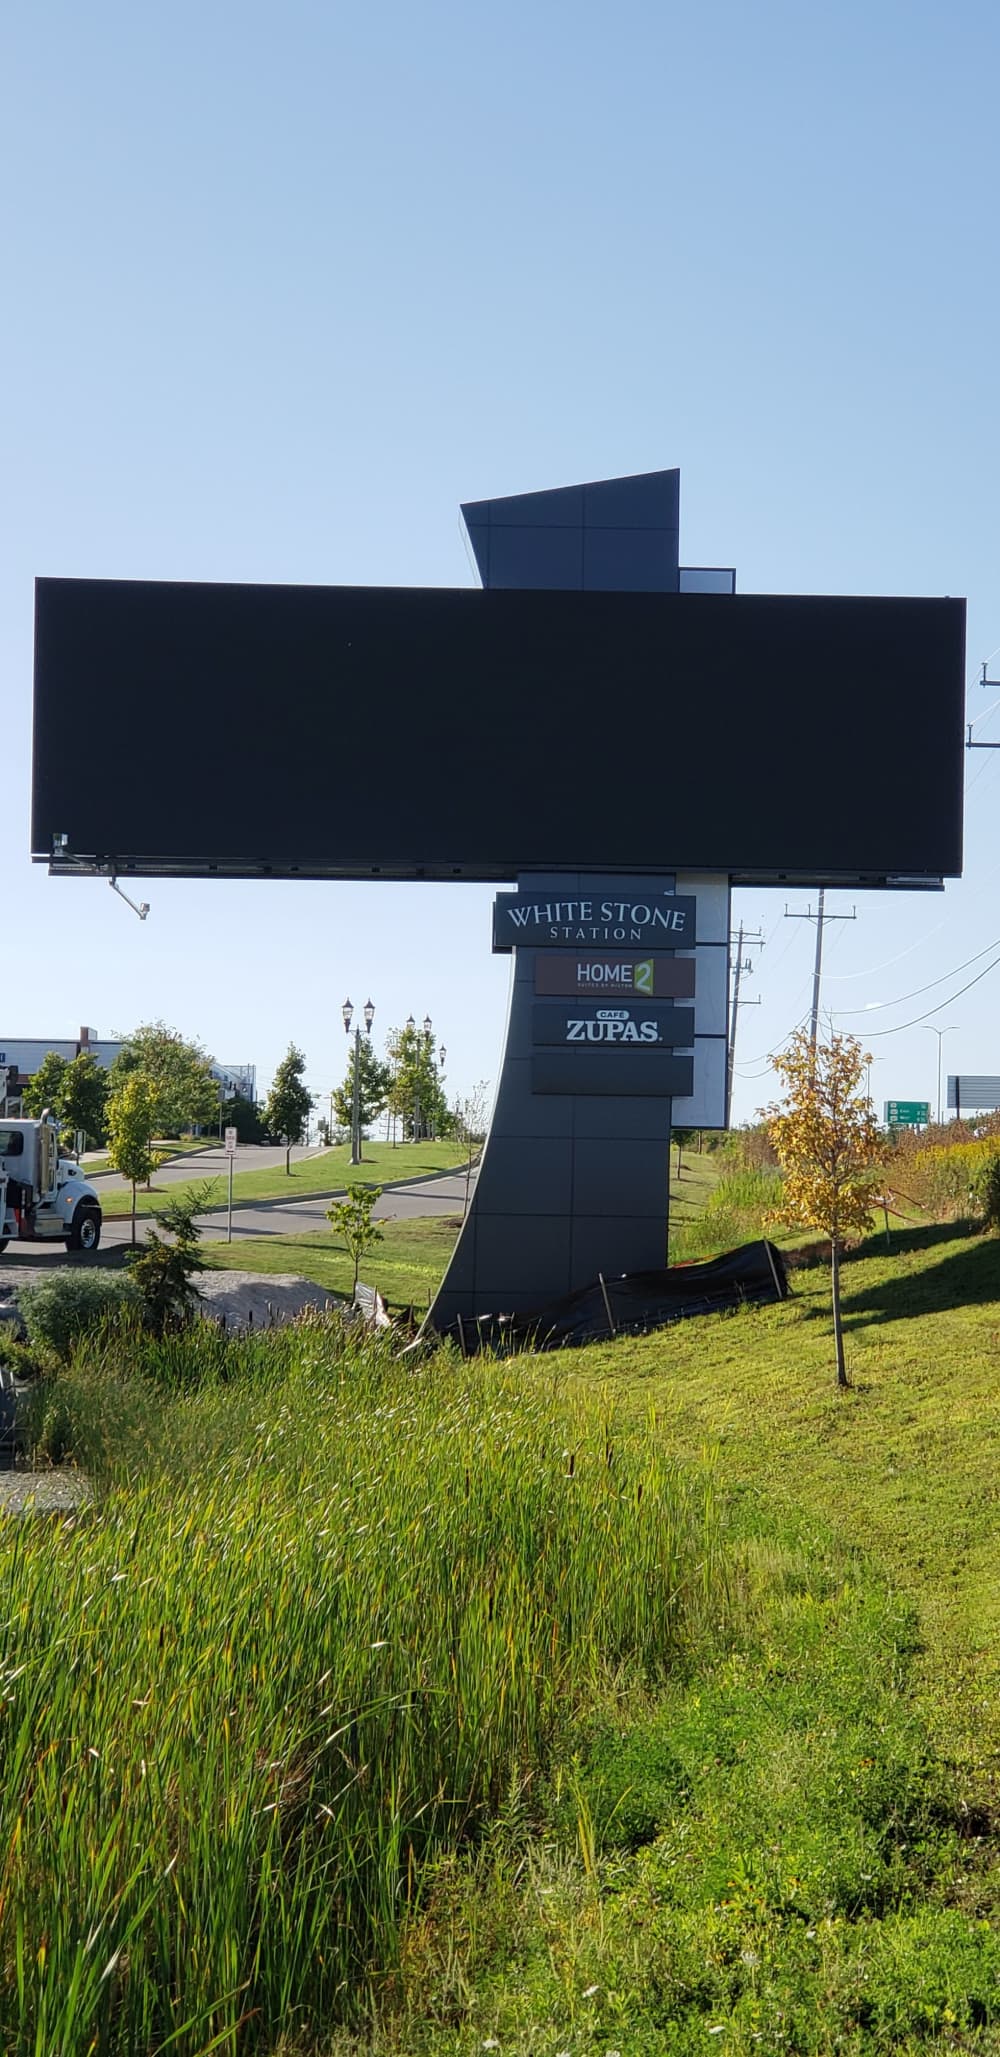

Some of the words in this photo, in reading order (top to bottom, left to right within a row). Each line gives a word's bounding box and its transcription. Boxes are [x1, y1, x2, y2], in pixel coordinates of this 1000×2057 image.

[507, 901, 593, 928] WHITE
[600, 902, 686, 932] STONE
[550, 926, 642, 940] STATION
